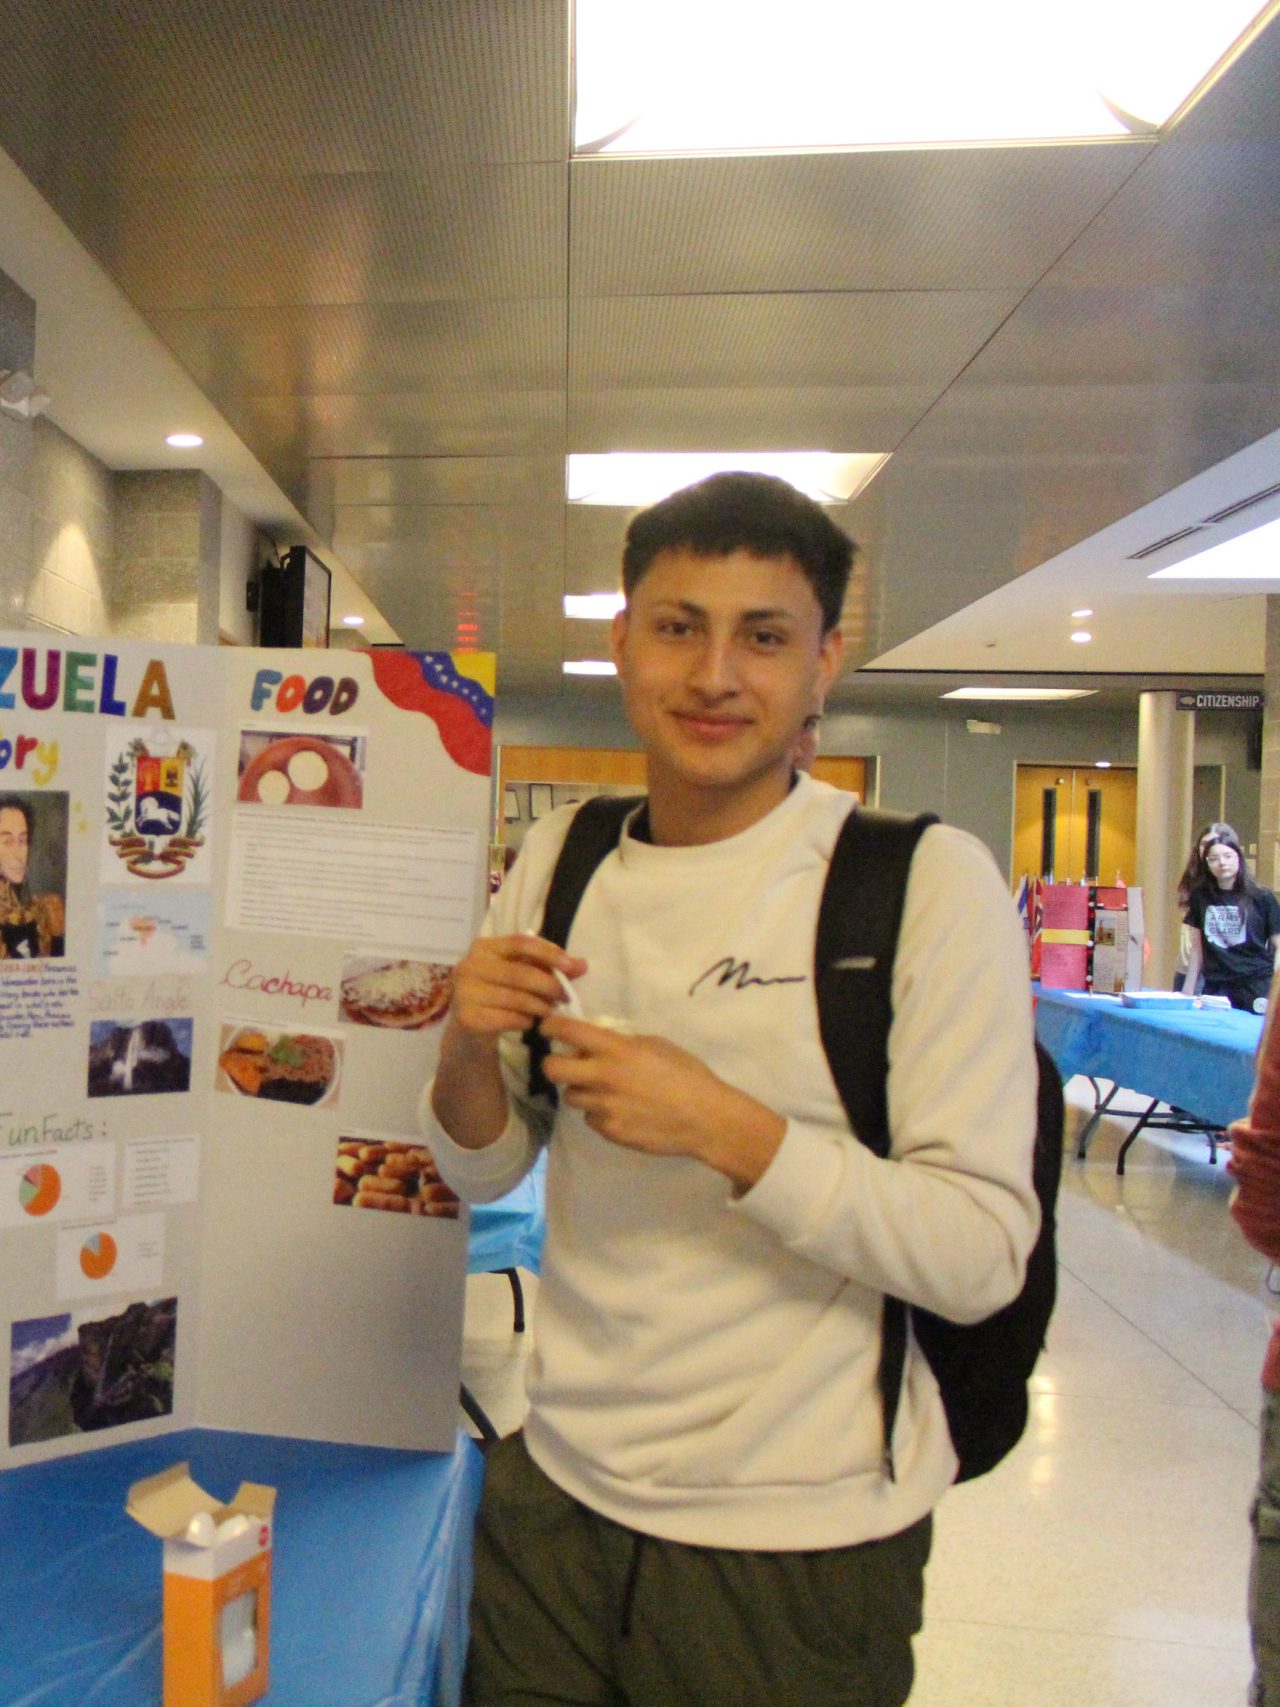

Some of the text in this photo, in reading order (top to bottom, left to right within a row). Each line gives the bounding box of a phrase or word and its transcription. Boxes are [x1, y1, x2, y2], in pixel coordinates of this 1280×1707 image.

[250, 668, 359, 716] FOOD
[1196, 694, 1260, 708] CITIZENSHIP
[1210, 912, 1239, 921] ARMY
[1209, 927, 1241, 935] GUARD
[219, 958, 333, 1008] Cachapa
